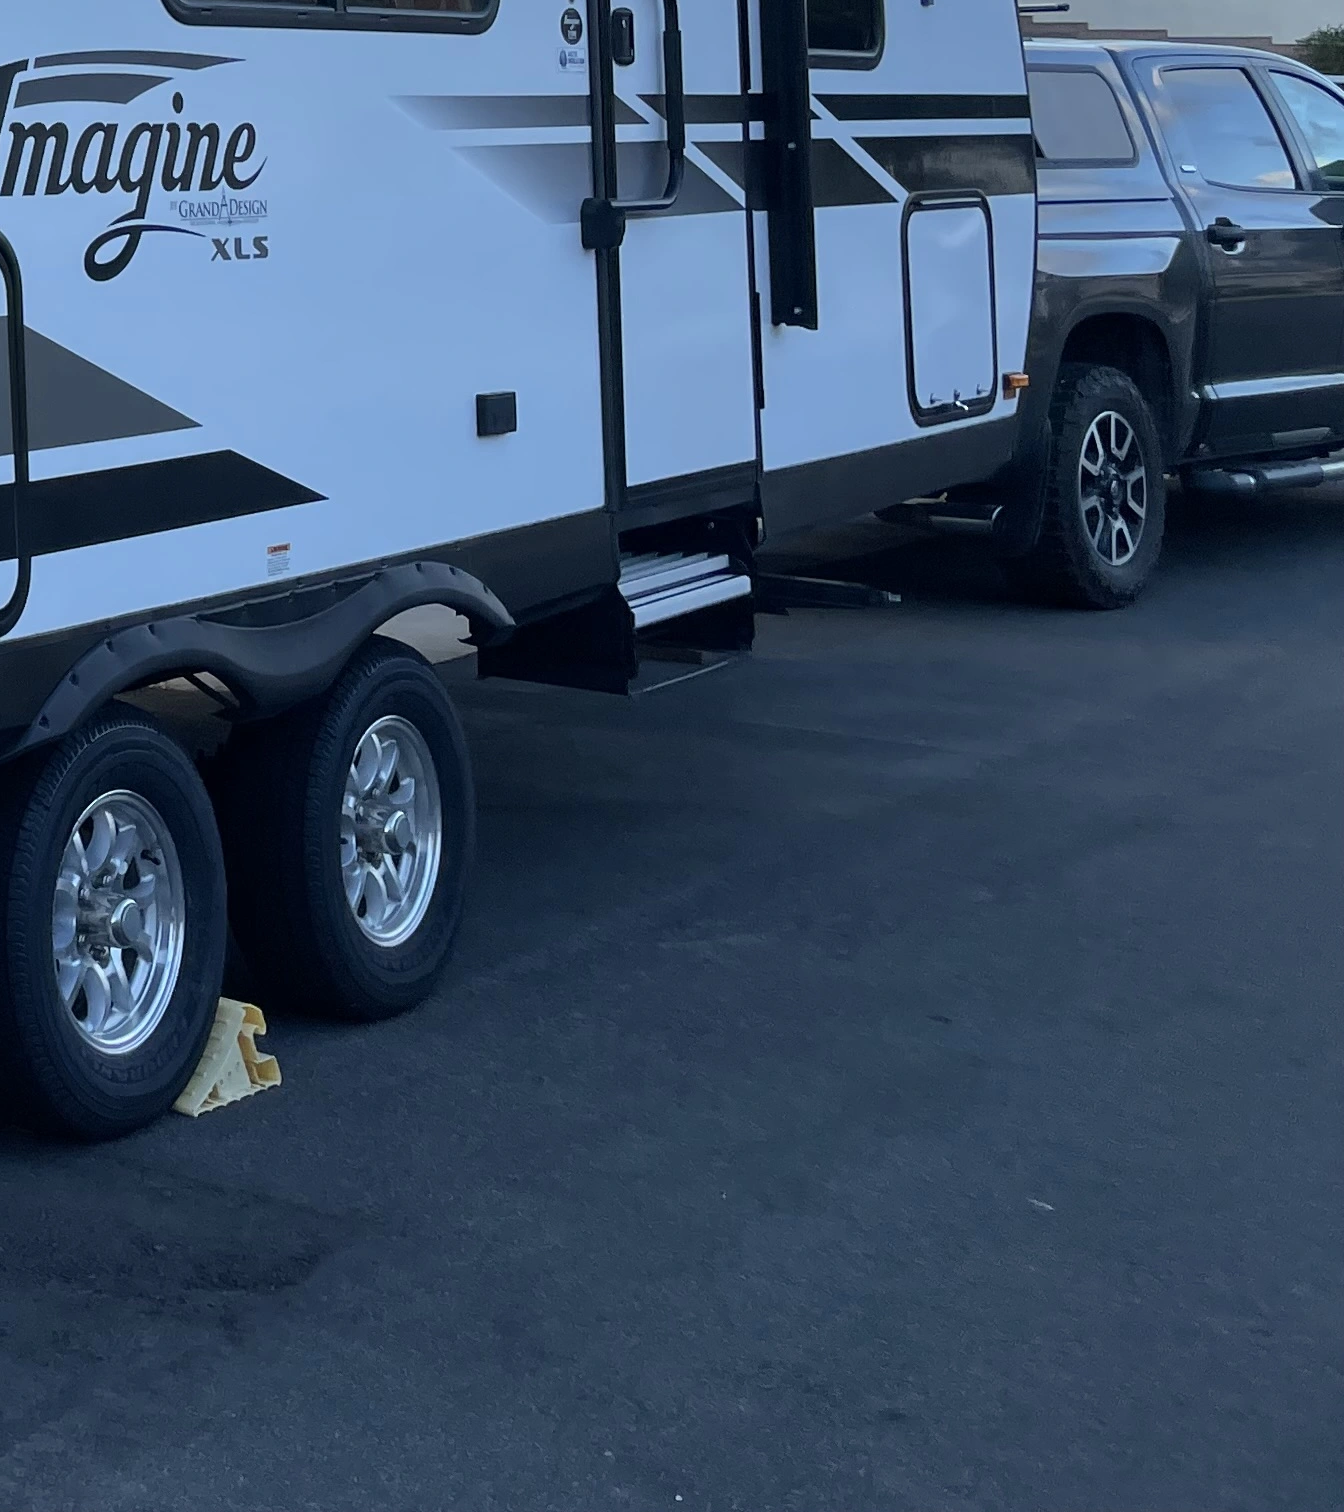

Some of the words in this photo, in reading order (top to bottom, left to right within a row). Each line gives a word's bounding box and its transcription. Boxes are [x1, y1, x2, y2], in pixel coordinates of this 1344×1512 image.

[178, 199, 219, 218] GRAND
[229, 198, 268, 216] DESIGN
[210, 235, 269, 262] XLS
